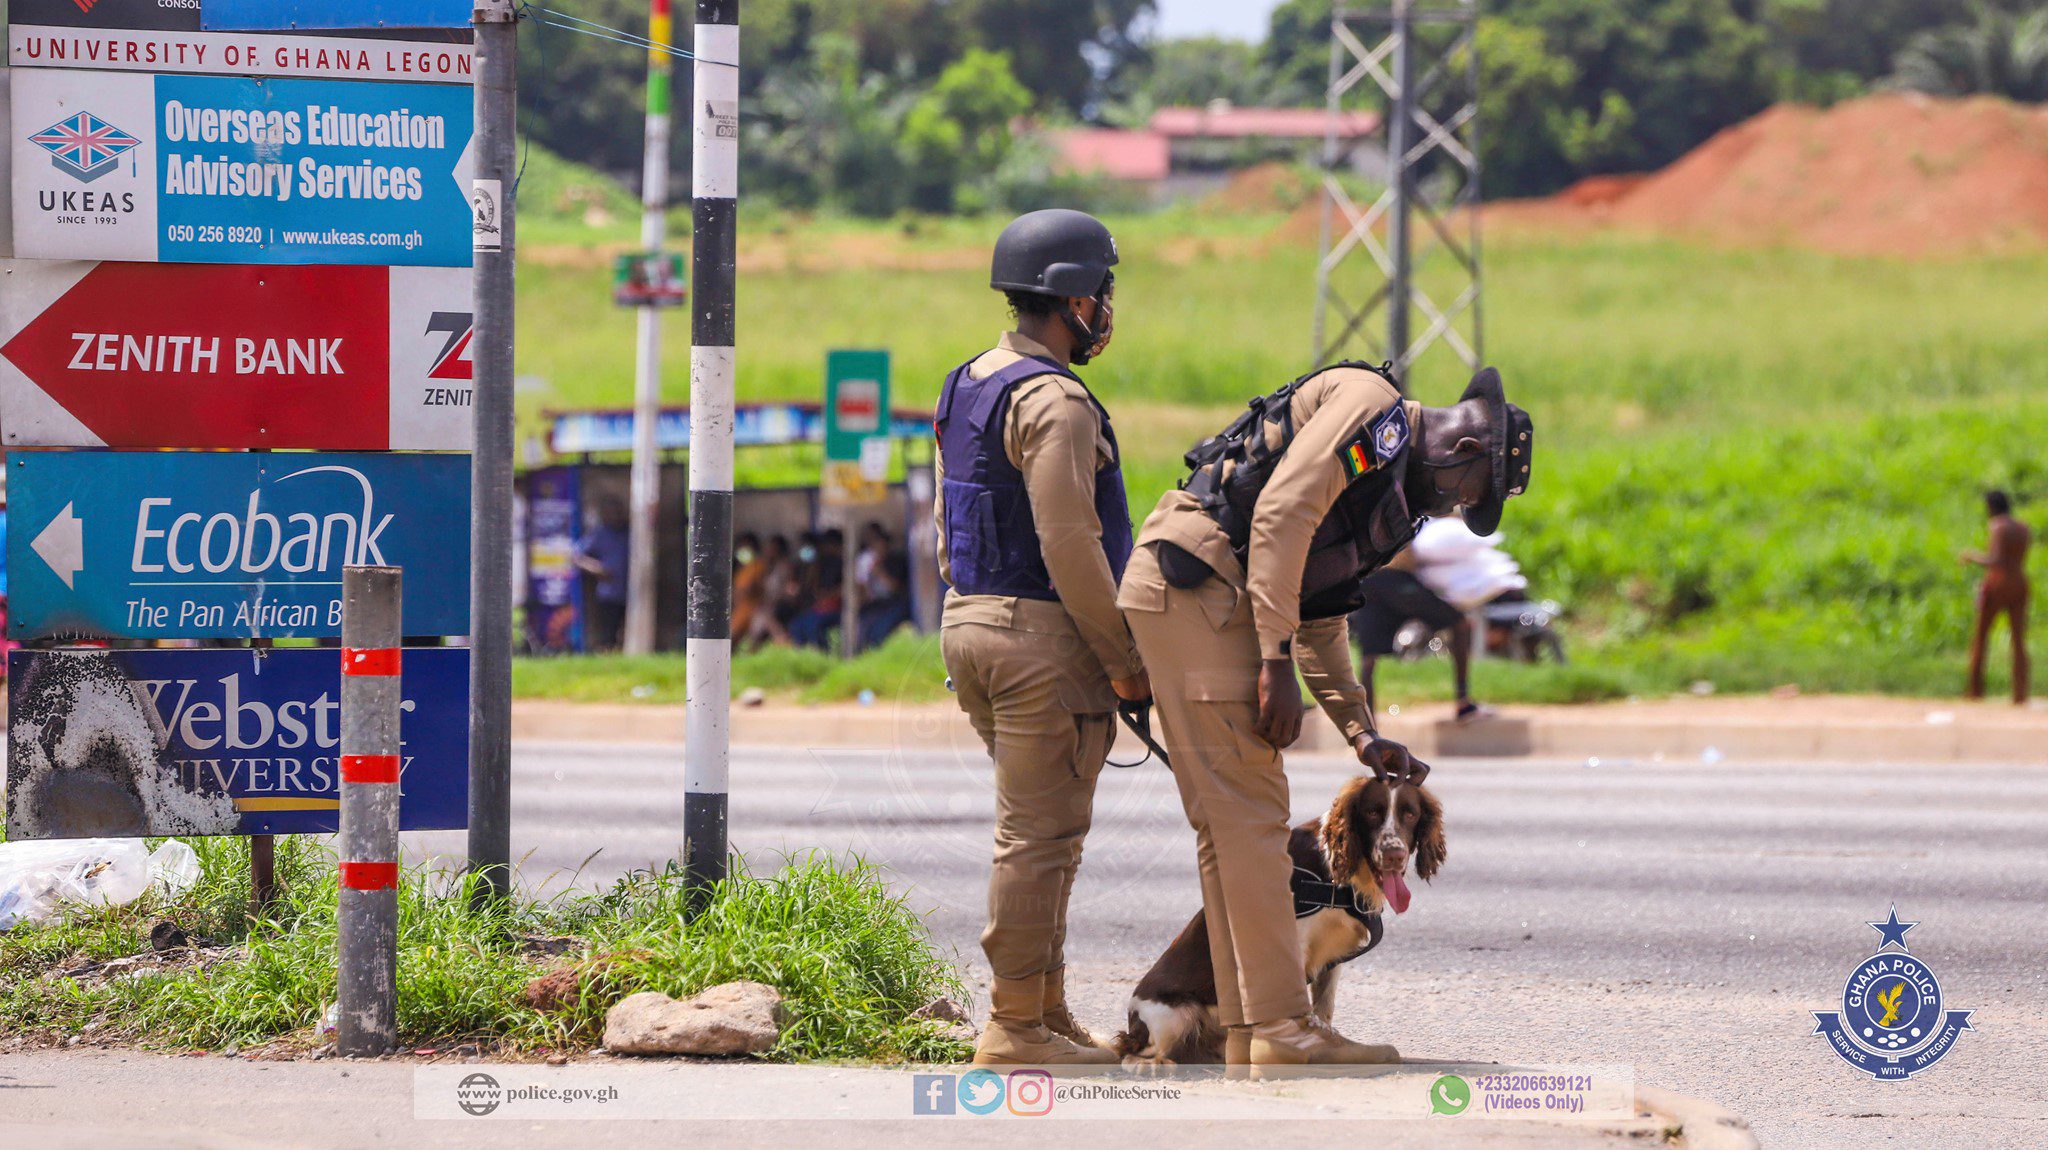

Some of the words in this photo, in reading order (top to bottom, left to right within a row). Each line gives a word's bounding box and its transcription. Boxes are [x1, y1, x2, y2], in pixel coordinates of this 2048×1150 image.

[157, 0, 201, 10] CONSOL
[26, 37, 207, 65] UNIVERSITY
[224, 45, 257, 67] OF
[274, 46, 371, 71] GHANA
[386, 51, 472, 75] LEGON
[165, 99, 301, 145] Overseas
[306, 104, 445, 149] Education
[165, 153, 293, 202] Advisory
[298, 156, 423, 201] Services
[39, 190, 135, 214] UKEAS
[57, 215, 86, 225] SINCE
[94, 216, 117, 225] 1993
[167, 224, 194, 243] 050
[198, 225, 224, 243] 256
[227, 226, 262, 243] 8920
[282, 228, 423, 251] www.ukeas.com.gh
[67, 332, 221, 374] ZENITH
[235, 337, 345, 375] BANK
[423, 388, 473, 406] ZENIT
[131, 465, 395, 573] Ecobank
[126, 597, 169, 628] The
[178, 599, 224, 628] Pan
[233, 597, 318, 628] African
[128, 672, 416, 750] Webst
